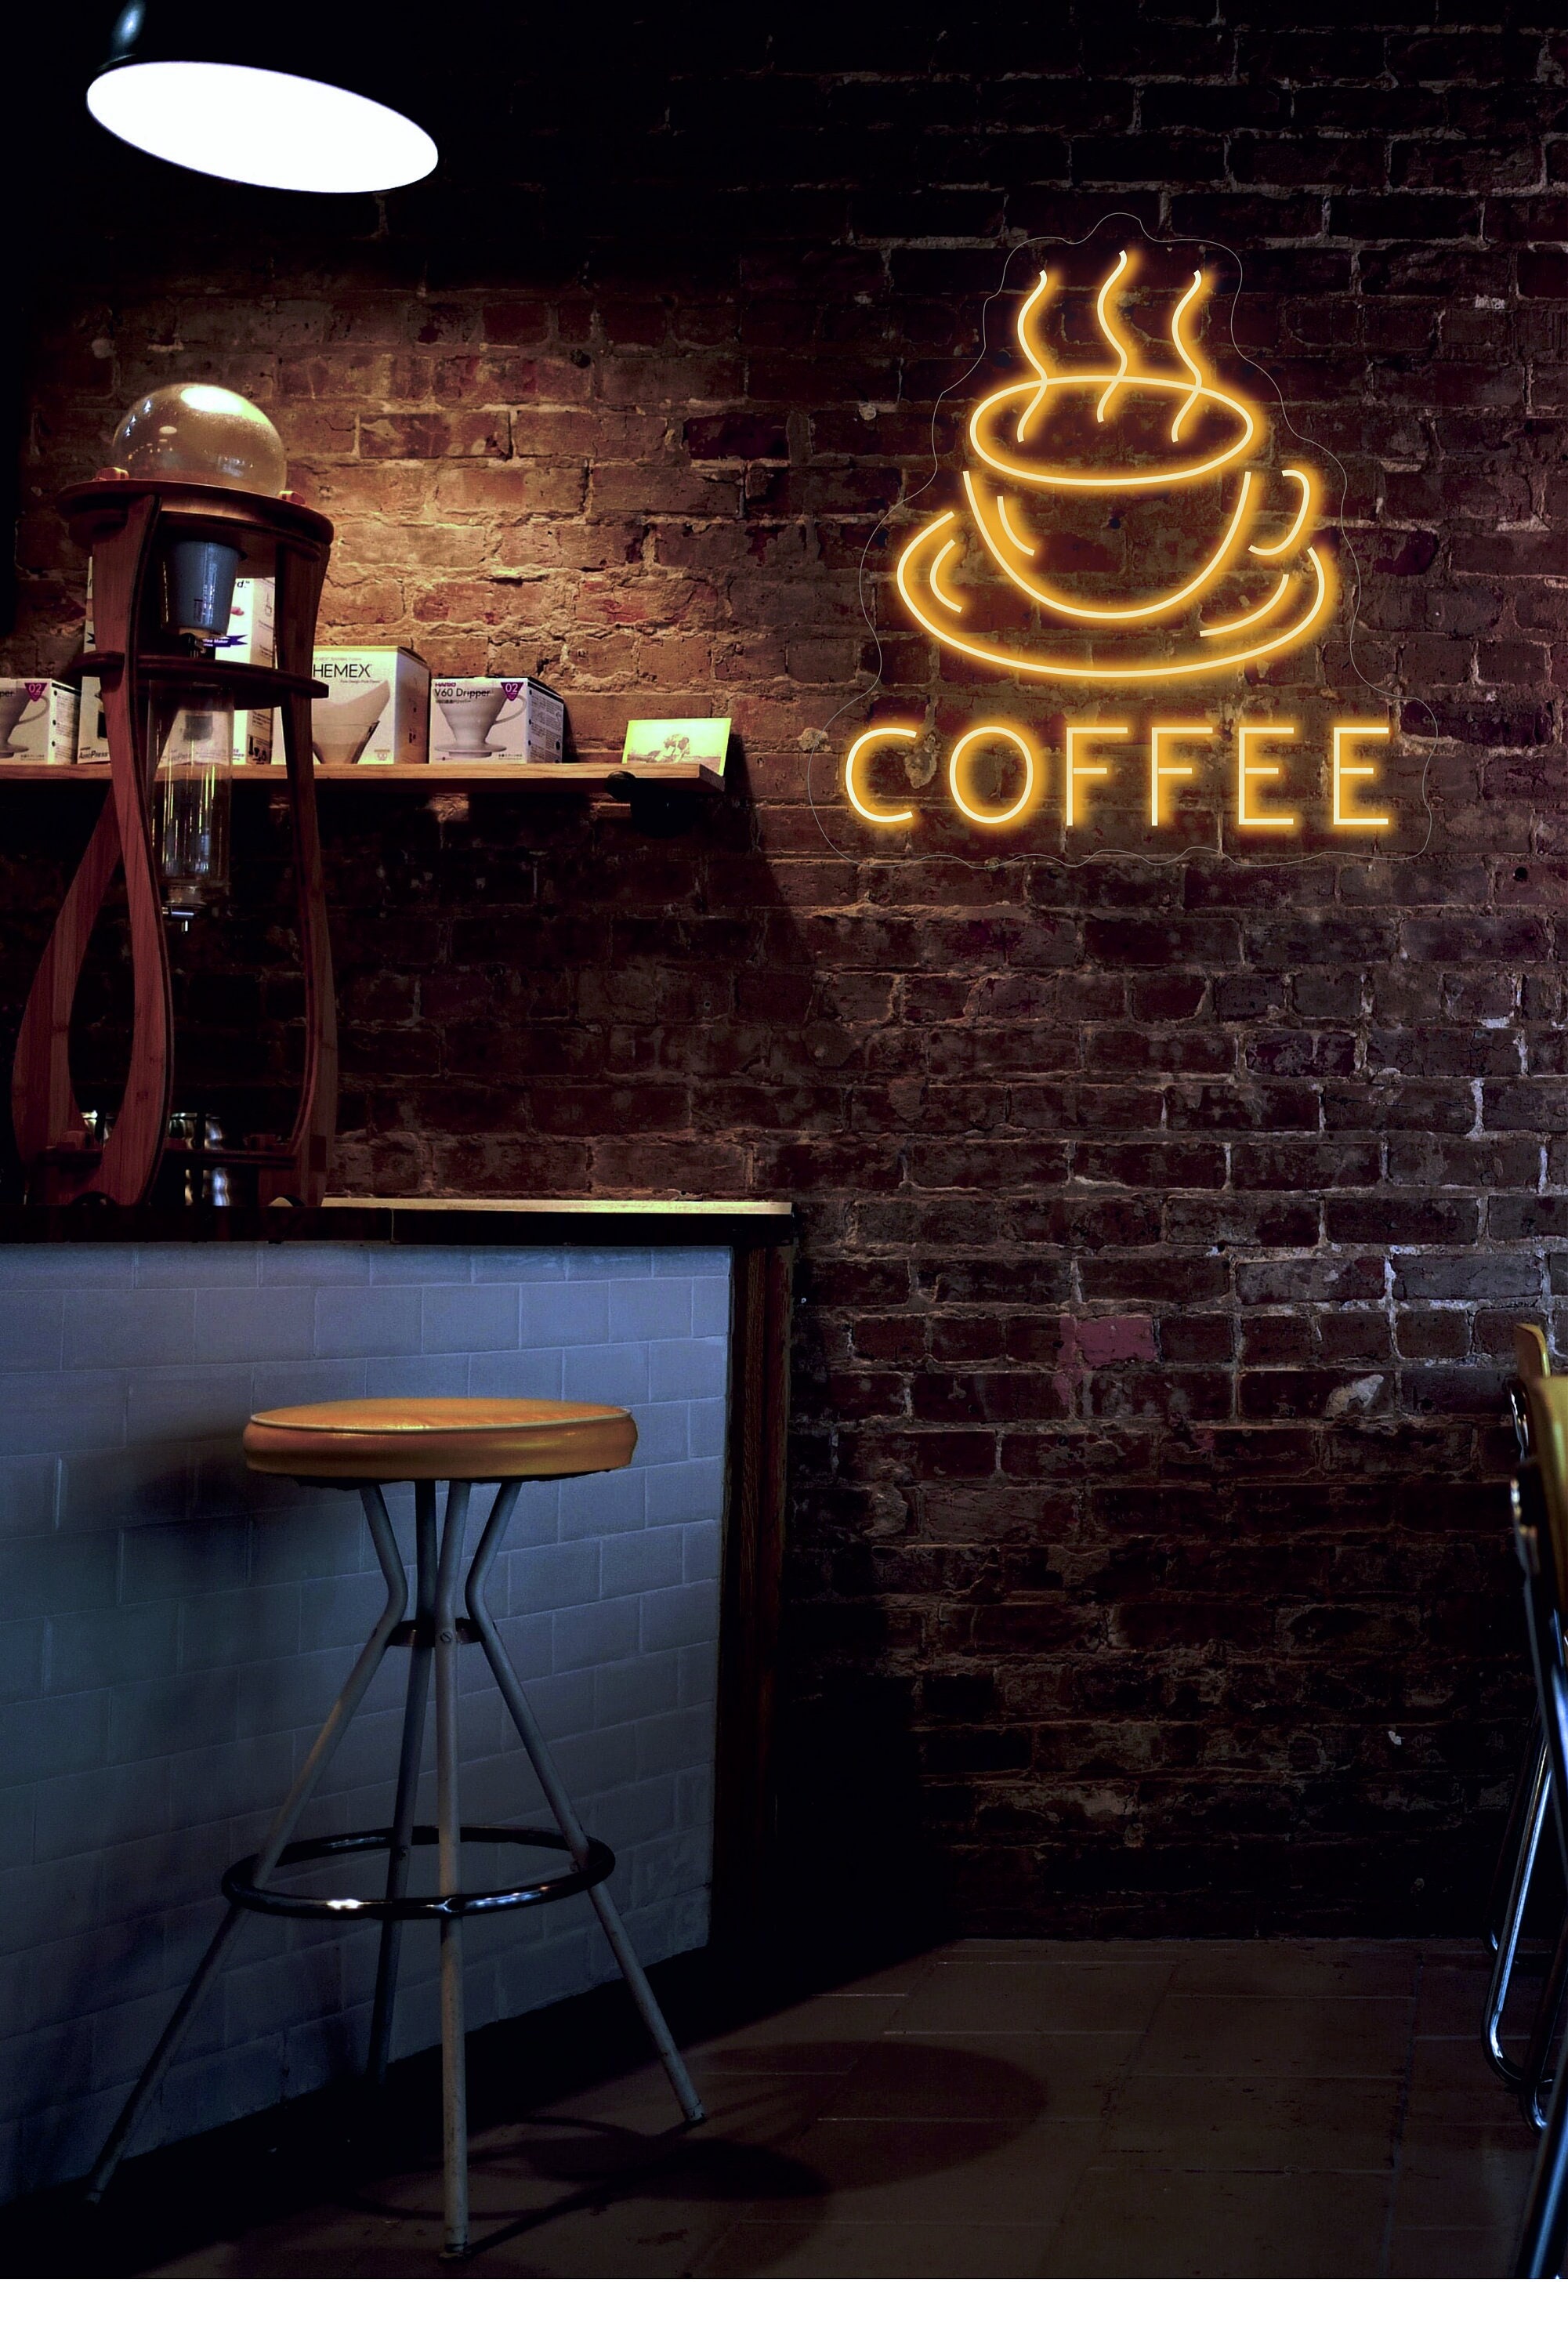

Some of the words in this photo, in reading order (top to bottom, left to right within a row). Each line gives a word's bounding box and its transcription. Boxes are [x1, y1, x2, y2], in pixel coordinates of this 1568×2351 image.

[313, 663, 371, 678] HEMEX
[28, 683, 42, 693] 02
[434, 688, 453, 697] V60
[456, 688, 491, 698] Dripper
[505, 683, 519, 693] 02
[0, 690, 15, 699] per
[845, 726, 1390, 827] COFFEE
